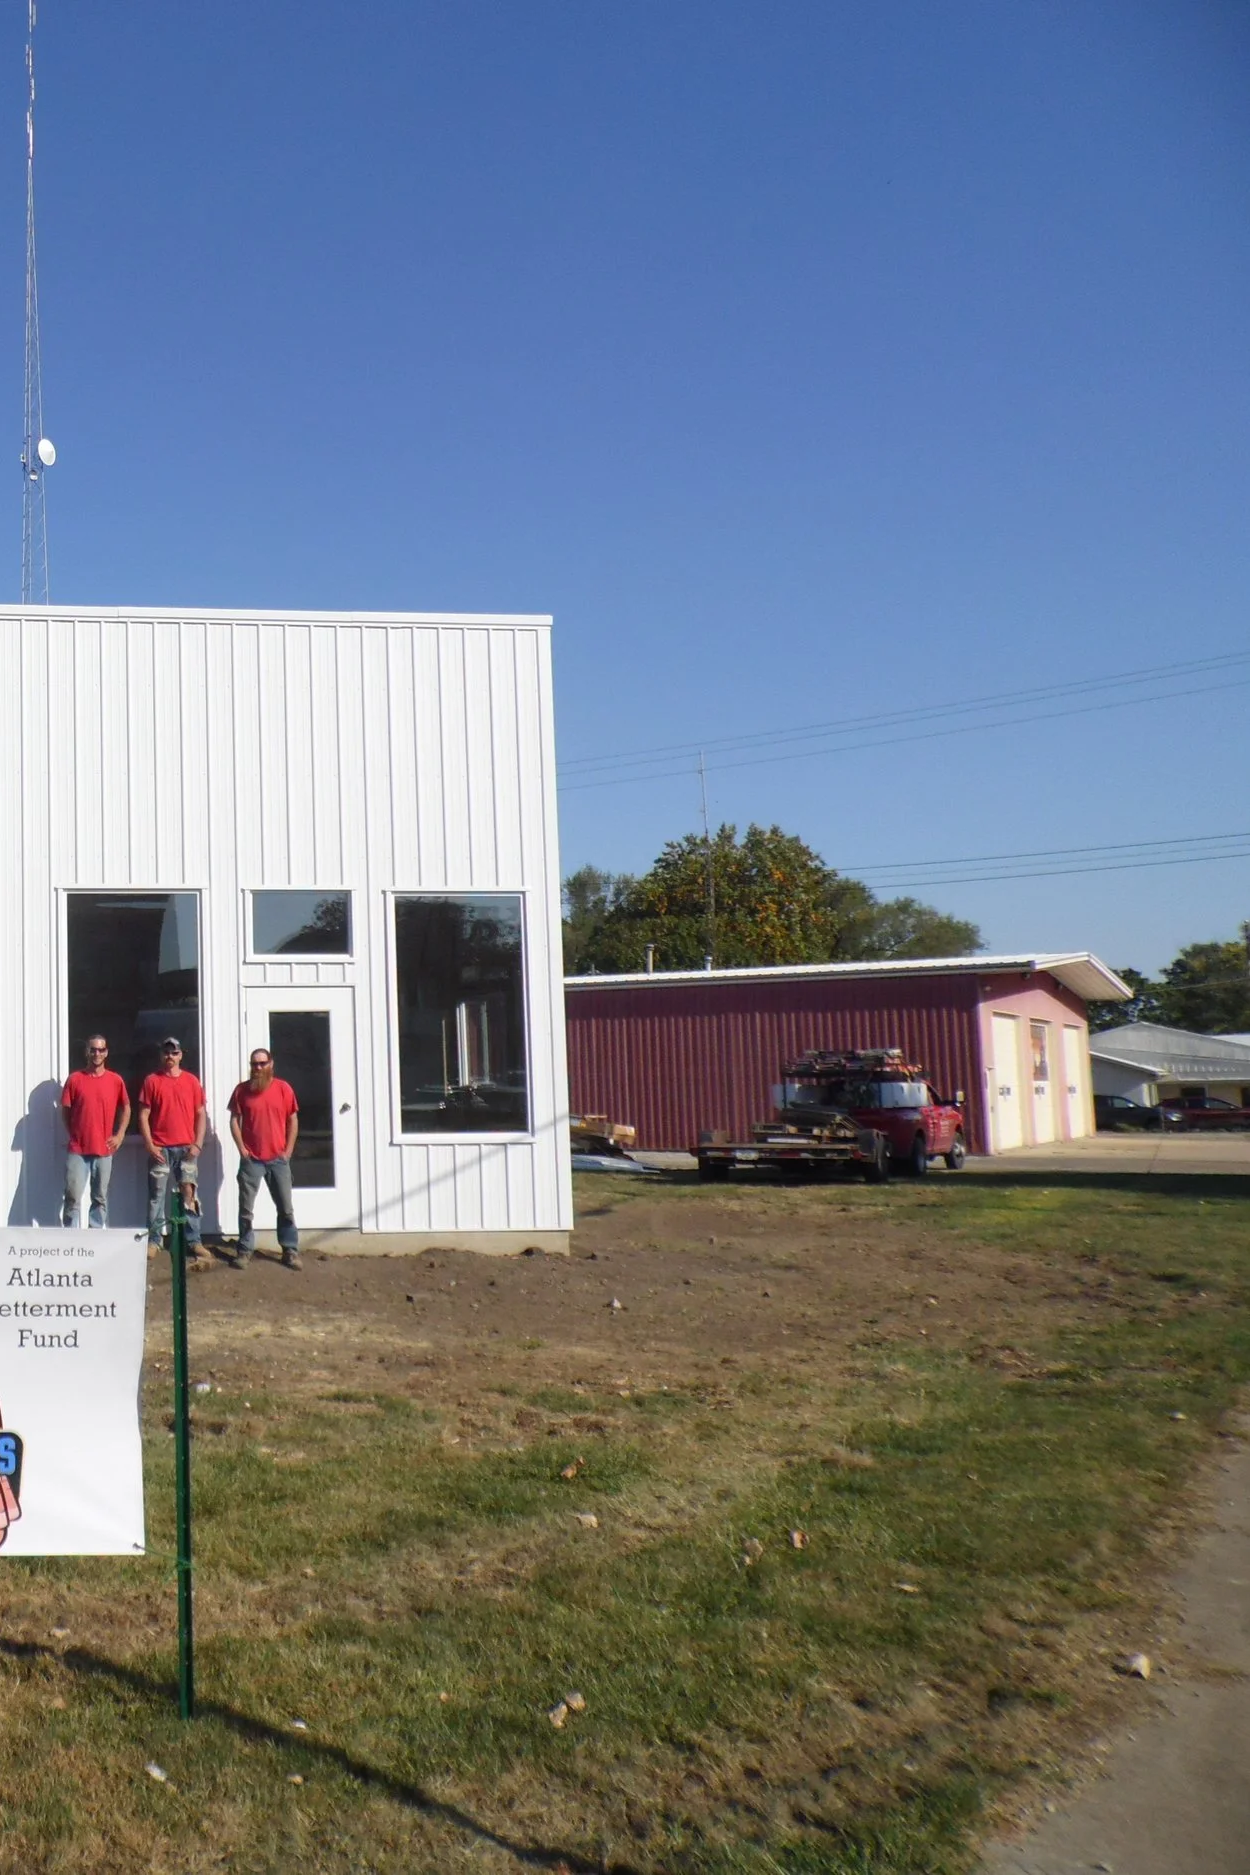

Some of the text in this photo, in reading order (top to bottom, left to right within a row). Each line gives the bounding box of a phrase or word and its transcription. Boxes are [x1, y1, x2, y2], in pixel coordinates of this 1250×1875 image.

[8, 1245, 95, 1258] A project of the
[6, 1267, 94, 1288] Atlanta
[17, 1329, 80, 1348] Fund
